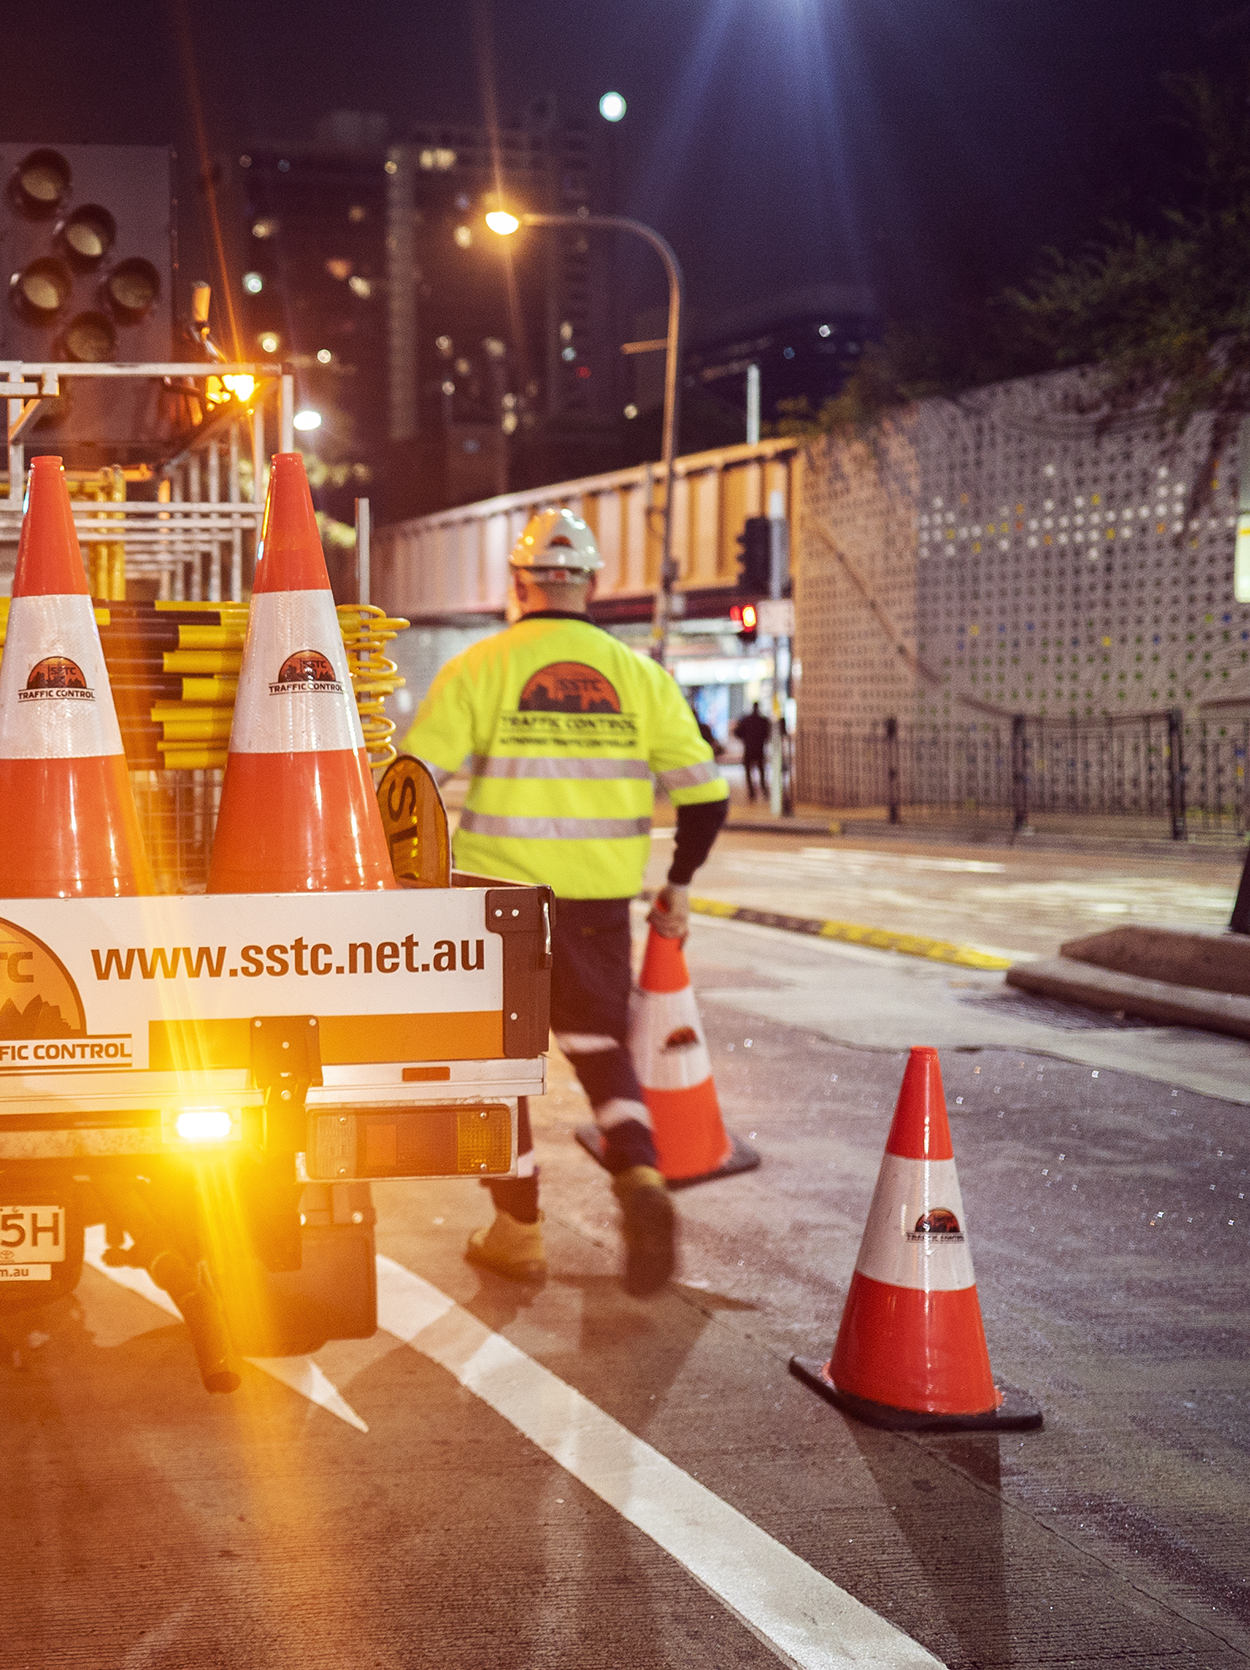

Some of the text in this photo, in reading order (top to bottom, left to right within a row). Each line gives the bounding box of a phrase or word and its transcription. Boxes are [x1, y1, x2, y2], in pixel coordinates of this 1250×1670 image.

[18, 689, 96, 700] TRAFFIC CONTROL
[269, 682, 344, 693] TRAFFIC CONTROL
[90, 933, 485, 981] www.sstc.net.au
[33, 1042, 132, 1060] CONTROL
